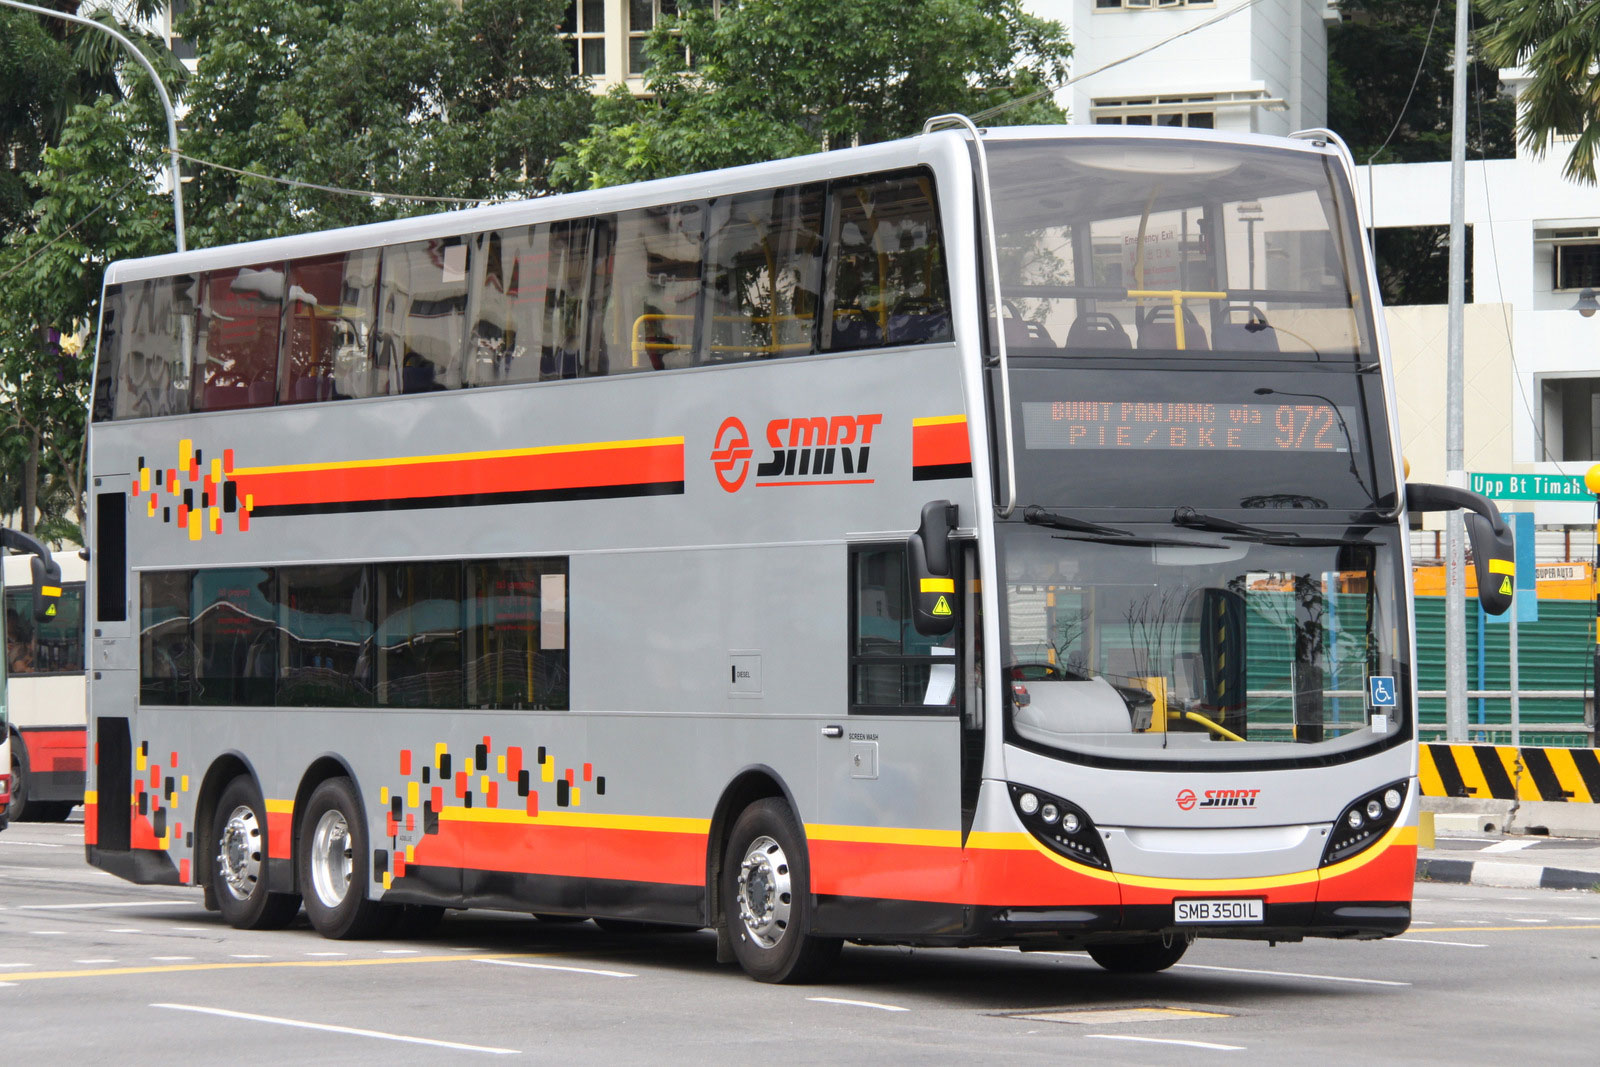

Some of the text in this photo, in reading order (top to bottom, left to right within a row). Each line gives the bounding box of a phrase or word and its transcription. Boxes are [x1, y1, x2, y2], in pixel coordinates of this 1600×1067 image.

[1161, 230, 1174, 241] Exit
[1052, 401, 1262, 424] BUKIT PANJANG via
[1275, 405, 1333, 448] 972
[756, 413, 883, 477] SMRT
[1474, 475, 1504, 497] Upp
[1510, 476, 1527, 494] Bt
[1534, 477, 1581, 495] Timah
[1536, 567, 1574, 579] SUPER AUTO
[849, 732, 879, 741] SCREEN WASH
[1200, 789, 1261, 807] SMRT
